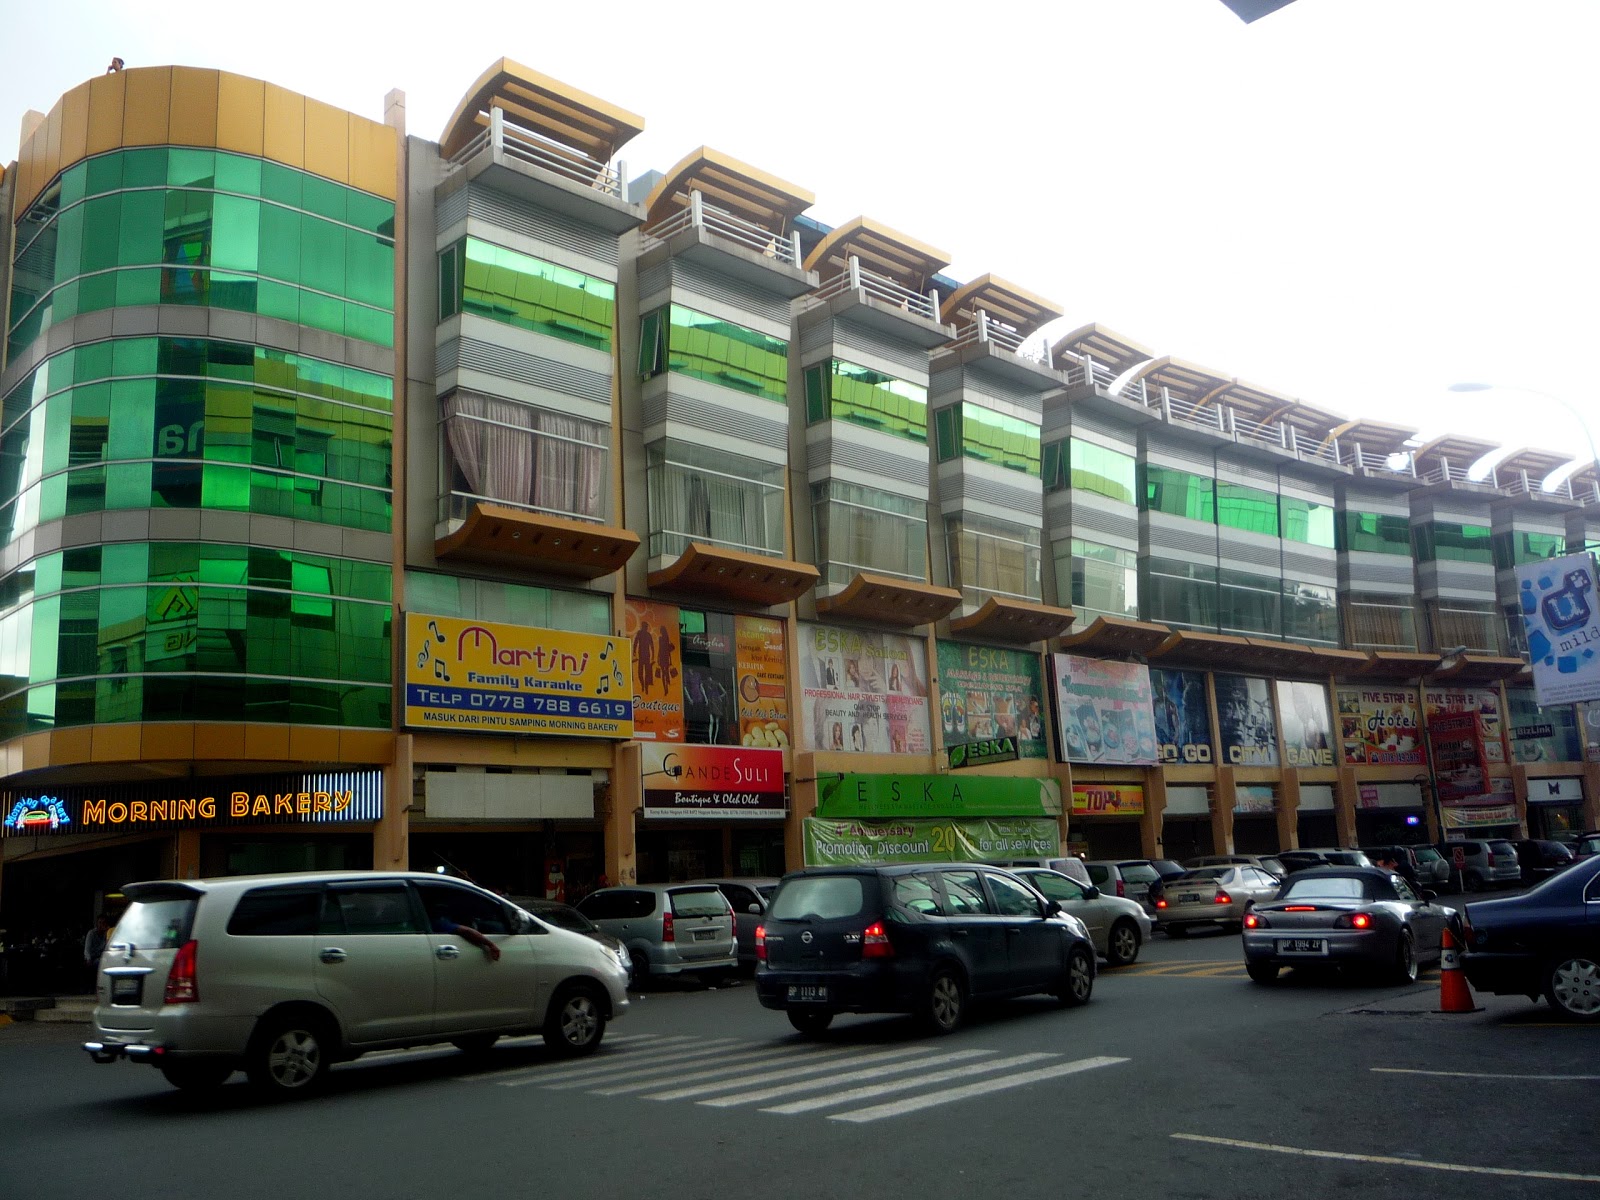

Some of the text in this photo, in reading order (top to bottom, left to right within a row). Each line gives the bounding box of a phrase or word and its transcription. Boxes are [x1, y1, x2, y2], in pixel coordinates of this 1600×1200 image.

[692, 634, 725, 649] Anglia
[815, 628, 908, 660] ESKA Salon
[1559, 626, 1600, 651] mild
[457, 626, 589, 676] Martini
[968, 646, 1009, 670] ESKA
[467, 671, 583, 692] Family Karaoke
[417, 689, 626, 716] TELP 0778 788 6619
[632, 695, 680, 716] Boutique
[804, 688, 846, 700] PROFESSIONAL
[848, 692, 860, 700] HAIR
[861, 693, 885, 703] STYLISTS
[1362, 692, 1414, 704] FIVE STAR 2
[1468, 694, 1474, 705] 2
[825, 709, 907, 721] BEAUTY AND HEALTH SERVICES
[867, 704, 881, 712] STOP
[423, 712, 619, 732] MASUK DARI PINTU SAMPING MORNING BAKERY
[1367, 709, 1416, 731] Hotel
[1517, 725, 1551, 735] BizLink
[967, 738, 1015, 758] ESKA
[1184, 744, 1211, 762] GO
[1229, 745, 1268, 763] CITY
[1286, 748, 1333, 765] GAME
[83, 790, 352, 825] MORNING BAKERY
[675, 792, 711, 807] Boutique
[722, 793, 740, 804] Oleh
[742, 794, 759, 804] Oleh
[5, 796, 38, 826] Morning
[816, 826, 1051, 856] Promotion Discount 20% for all services
[850, 824, 914, 838] Anniversary
